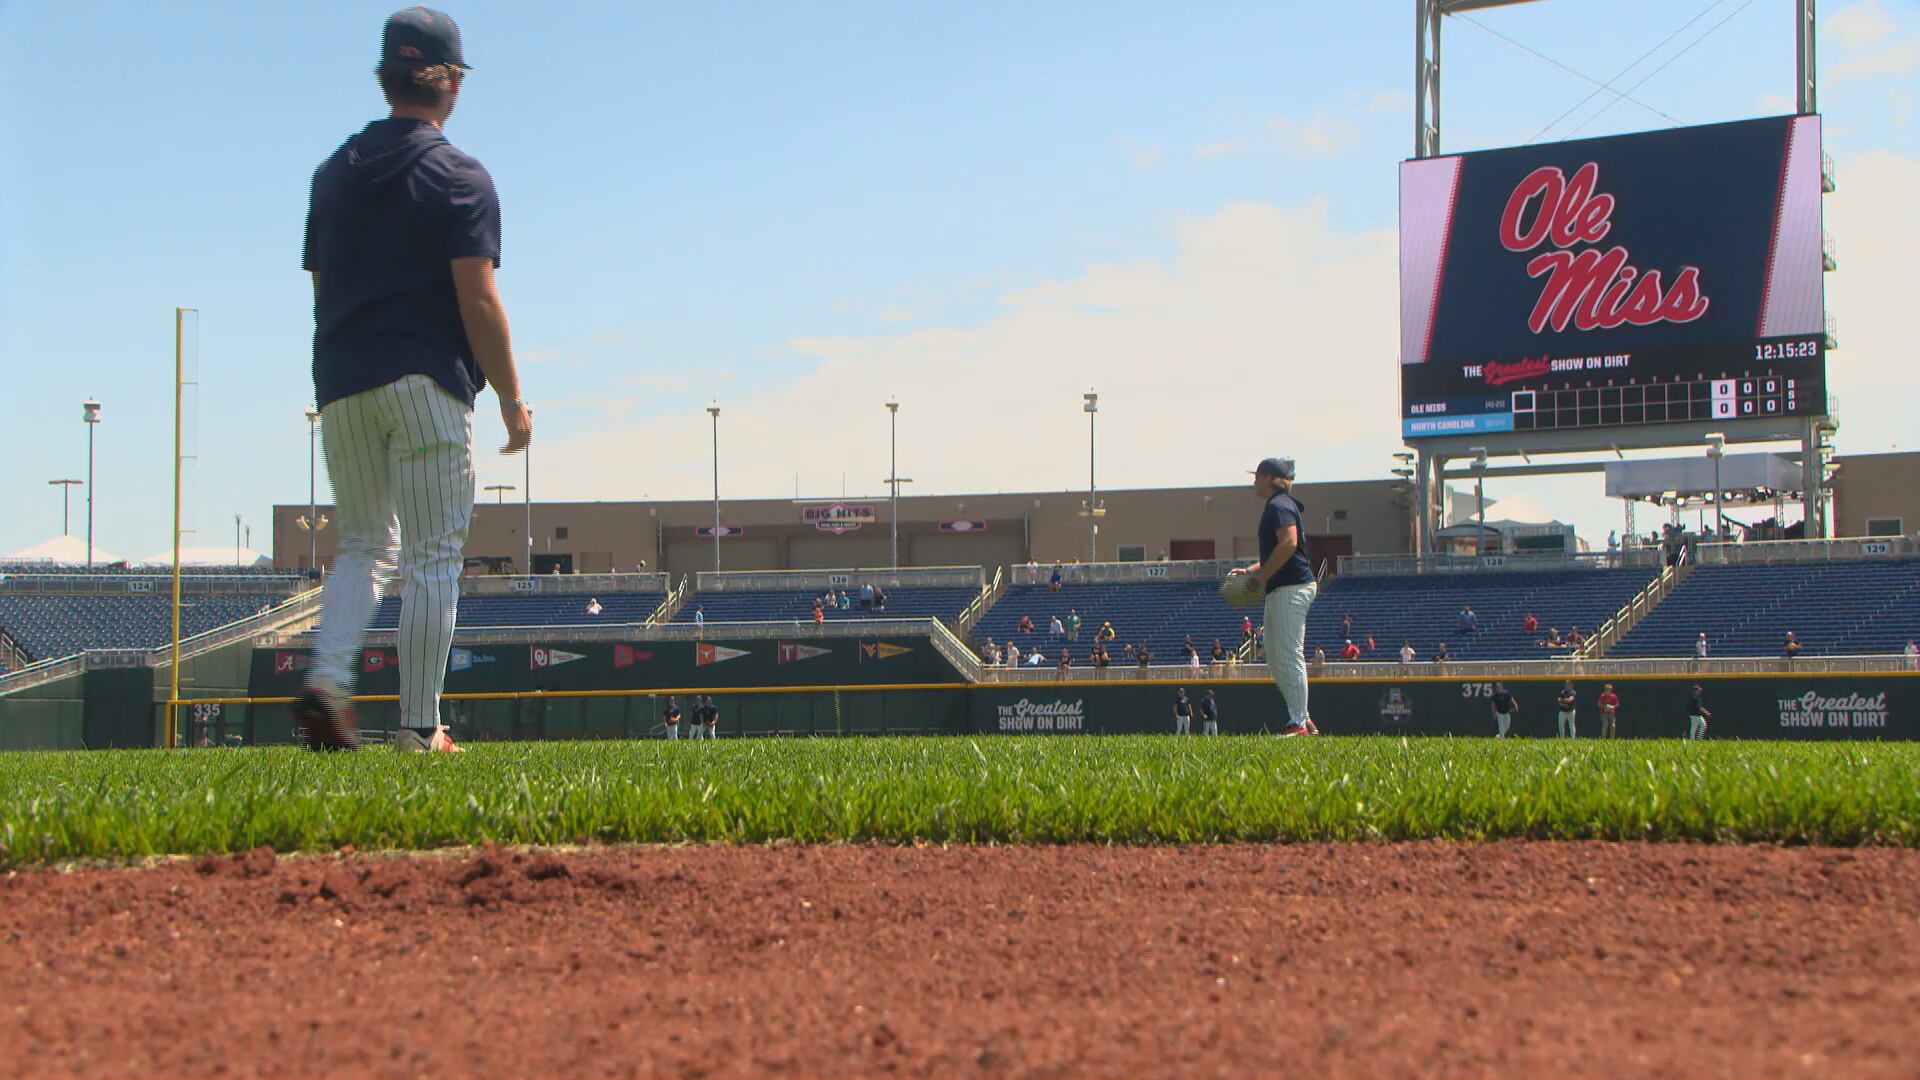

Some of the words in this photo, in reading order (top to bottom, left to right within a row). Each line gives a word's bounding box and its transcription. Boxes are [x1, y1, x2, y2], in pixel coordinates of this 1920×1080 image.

[1499, 161, 1615, 252] Ole
[1526, 245, 1709, 334] Miss
[1755, 341, 1817, 360] 12:15:23
[1463, 365, 1483, 378] THE
[1484, 355, 1550, 384] Greatest
[1551, 358, 1584, 371] SHOW
[1586, 356, 1601, 369] ON
[1604, 354, 1631, 368] DIRT
[1410, 403, 1424, 414] OLE
[1426, 402, 1447, 413] MISS
[1720, 384, 1728, 395] 0
[1744, 382, 1752, 393] 0
[1766, 380, 1775, 392] 0
[1411, 421, 1436, 431] NORTH
[1437, 419, 1475, 430] CAROLINA
[1720, 403, 1728, 414] 0
[1744, 401, 1752, 413] 0
[1766, 400, 1776, 411] 0
[806, 508, 831, 519] BIG
[836, 506, 871, 518] HITS
[1867, 545, 1886, 553] 129
[1149, 568, 1164, 576] 127
[132, 582, 150, 590] 124
[534, 649, 548, 666] OU
[1462, 683, 1493, 697] 375
[194, 703, 221, 716] 335
[997, 705, 1013, 716] THE
[1013, 698, 1083, 719] Greatest
[1777, 699, 1797, 711] THE
[1798, 690, 1886, 714] Greatest
[999, 716, 1034, 730] SHOW
[1037, 716, 1054, 730] ON
[1057, 716, 1084, 730] DIRT
[1780, 711, 1824, 727] SHOW
[1828, 711, 1849, 727] ON
[1852, 711, 1888, 727] DIRT
